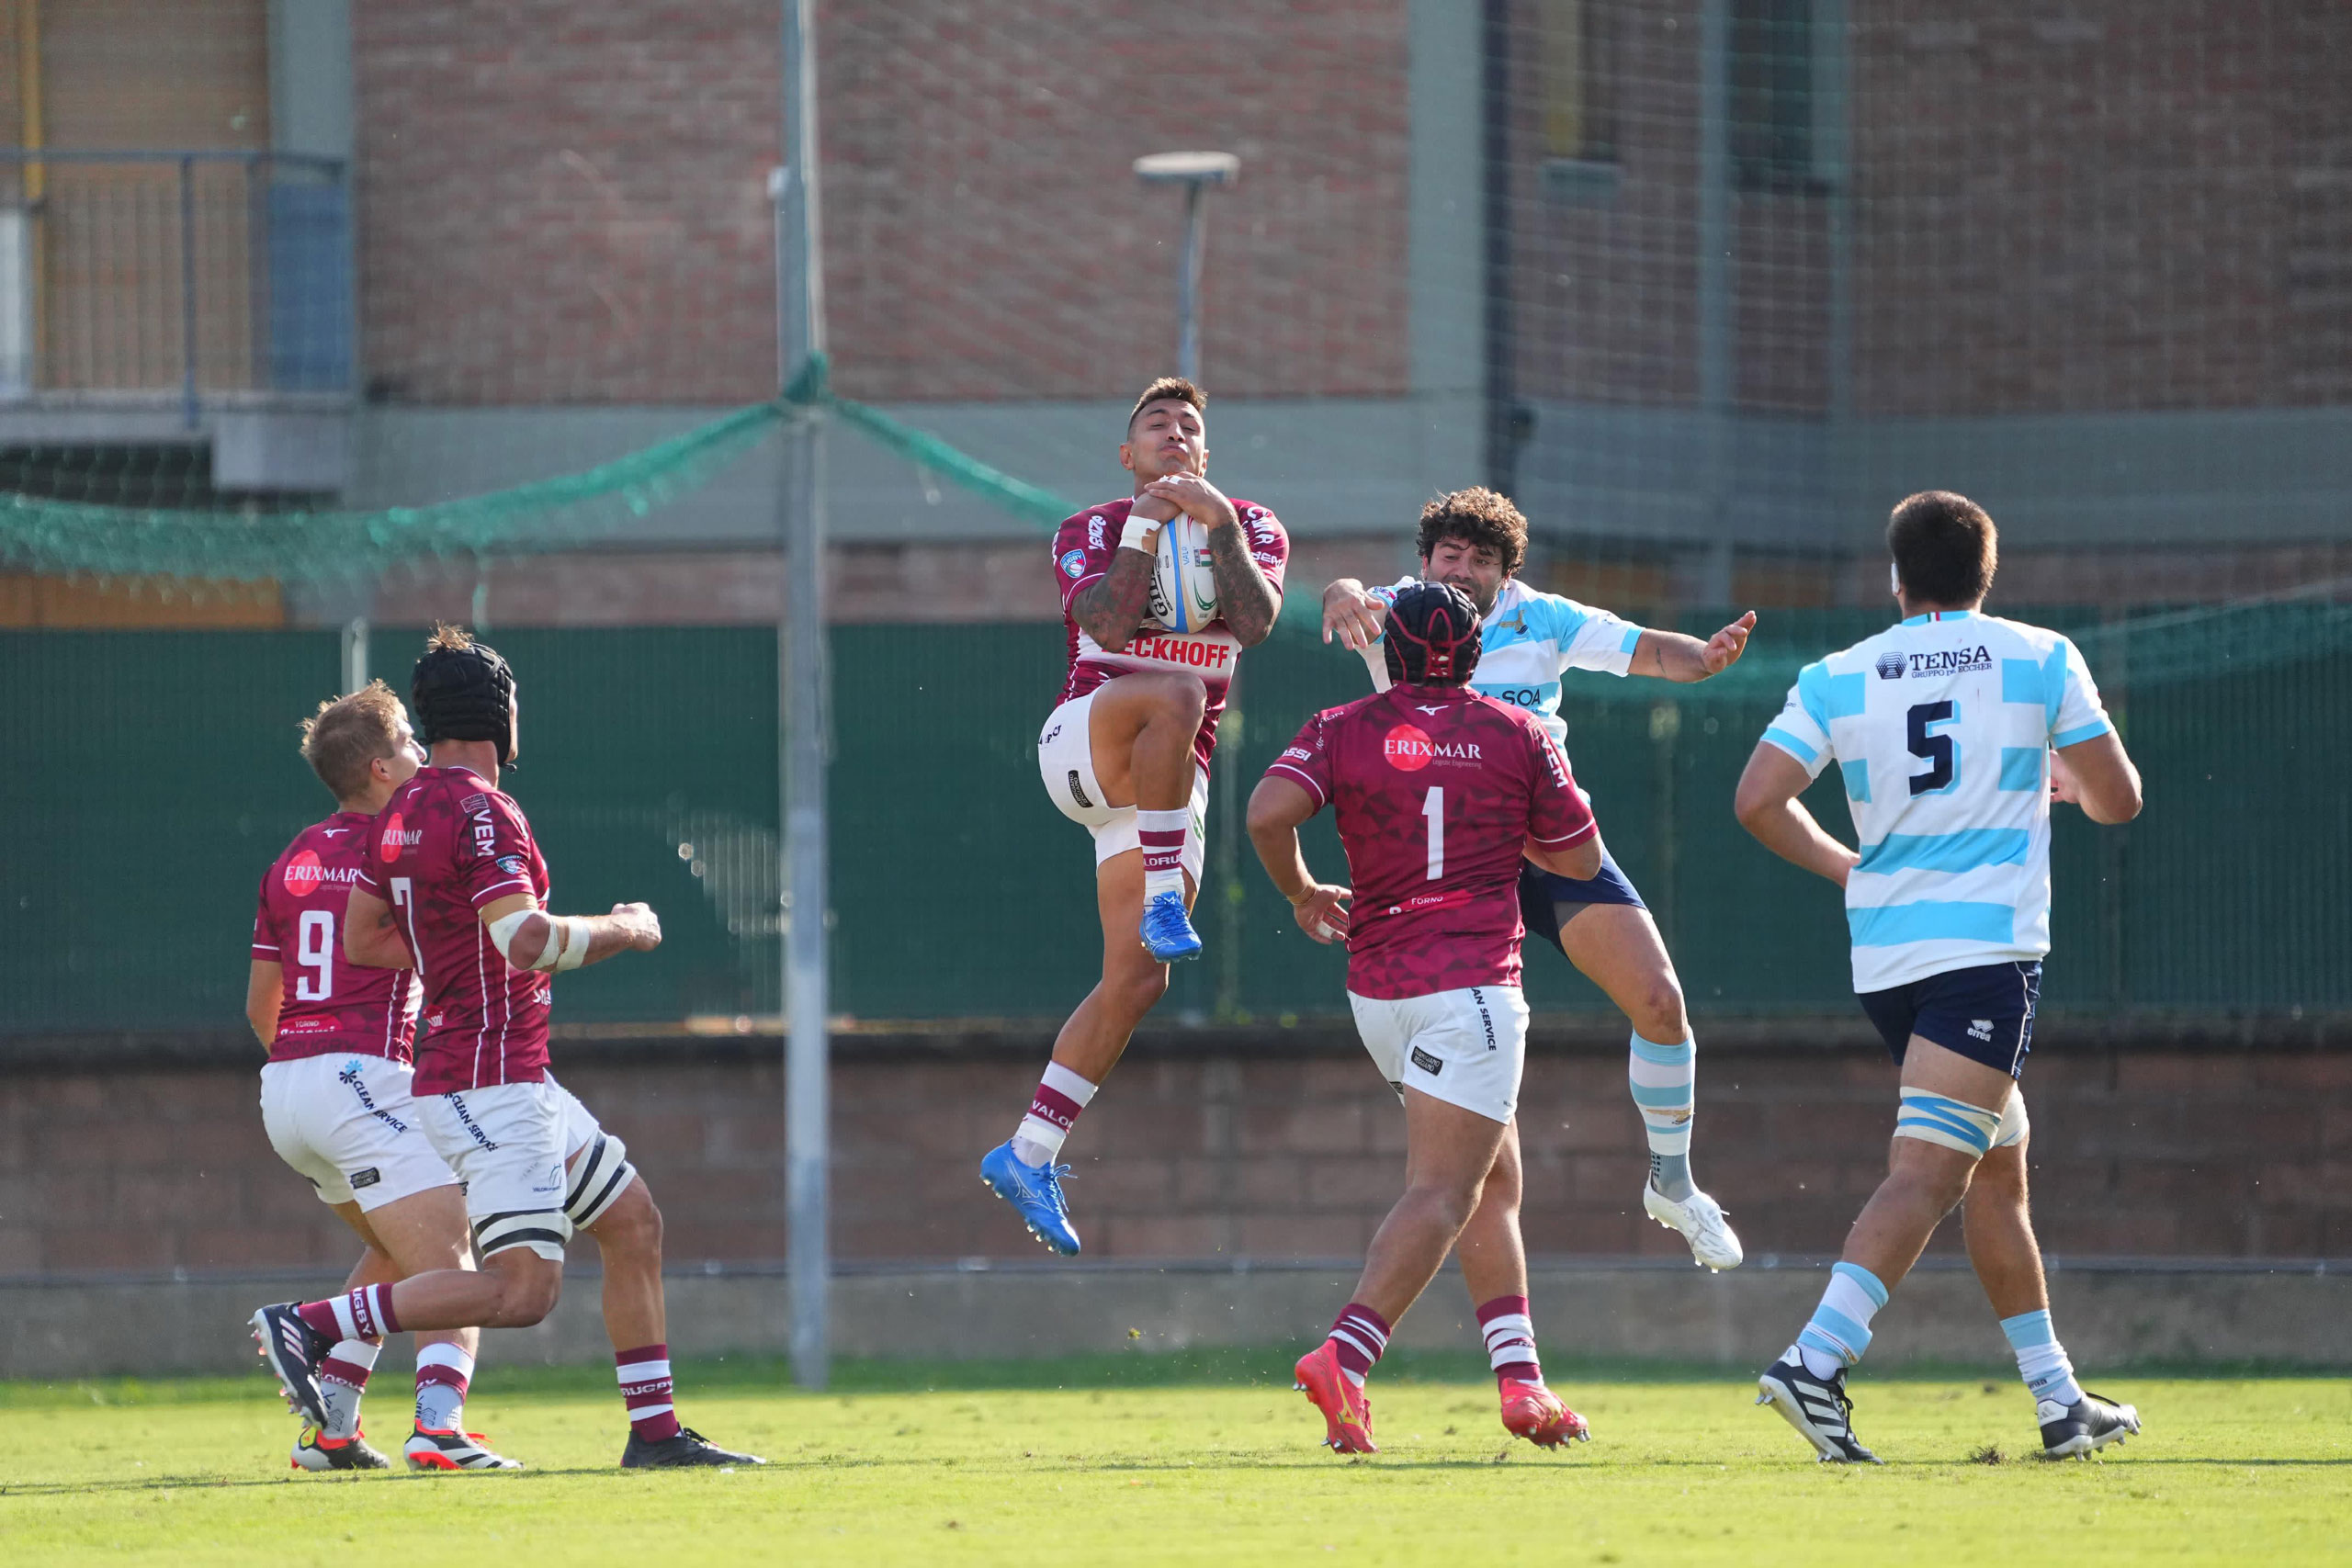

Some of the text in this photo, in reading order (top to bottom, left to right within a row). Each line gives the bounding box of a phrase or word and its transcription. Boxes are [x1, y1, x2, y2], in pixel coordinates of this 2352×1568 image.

[1102, 637, 1229, 669] ECKHOFF
[1909, 646, 1992, 671] TENSA
[1958, 662, 1993, 673] ECCHER
[1912, 669, 1945, 679] GRUPPO
[1384, 739, 1483, 760] ERIXMAR
[1907, 699, 1961, 798] 5
[473, 808, 495, 857] VEM
[1421, 786, 1444, 880] 1
[284, 865, 358, 883] ERIXMAR
[1411, 897, 1443, 905] FORNO
[390, 877, 424, 976] 7
[296, 910, 334, 1001] 9
[1480, 1008, 1497, 1052] SERVICE
[353, 1080, 375, 1111] CLEAN
[452, 1095, 472, 1125] CLEAN
[353, 1287, 373, 1335] UGBY
